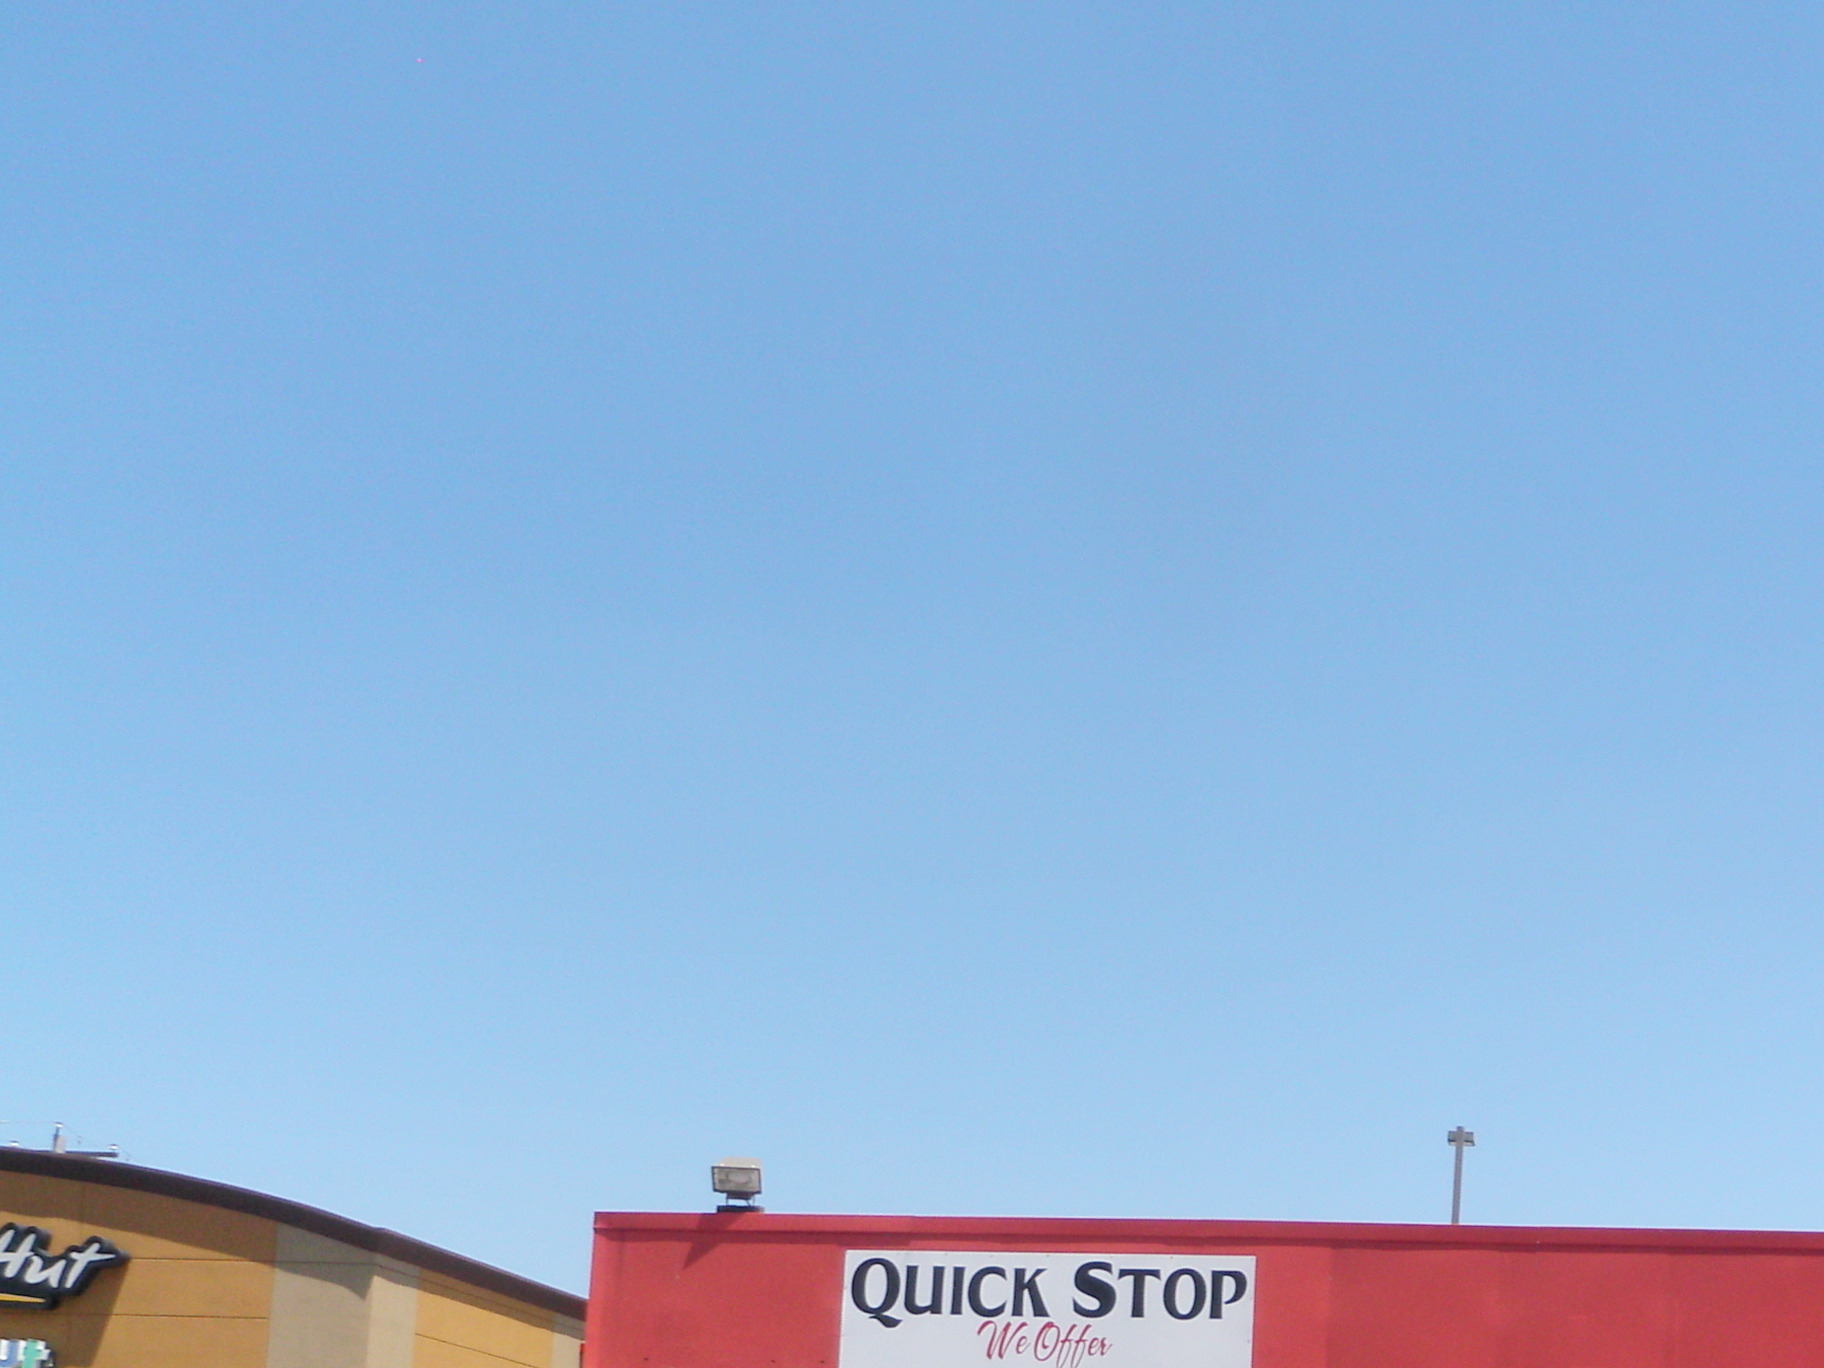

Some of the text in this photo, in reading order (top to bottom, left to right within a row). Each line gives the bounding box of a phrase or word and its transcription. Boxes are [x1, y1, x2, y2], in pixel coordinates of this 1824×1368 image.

[851, 1257, 1248, 1328] QUICK STOP
[977, 1320, 1031, 1360] We
